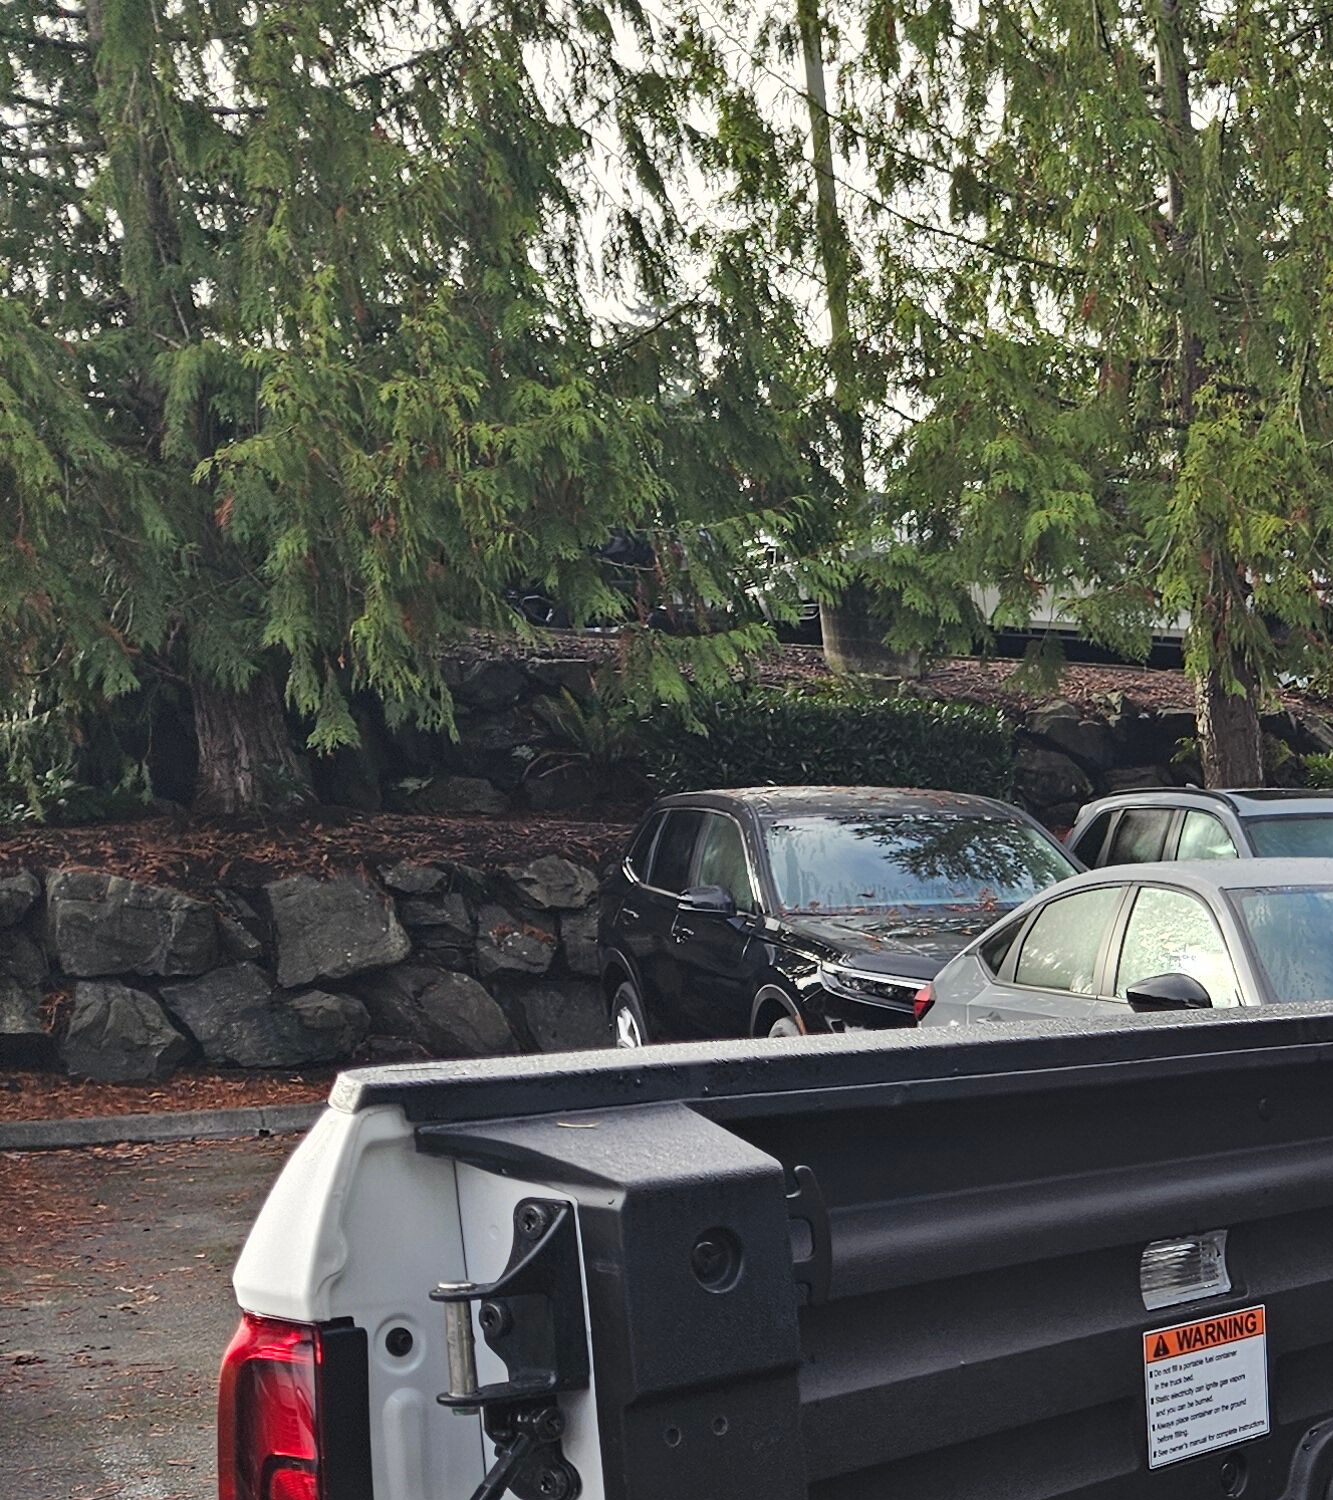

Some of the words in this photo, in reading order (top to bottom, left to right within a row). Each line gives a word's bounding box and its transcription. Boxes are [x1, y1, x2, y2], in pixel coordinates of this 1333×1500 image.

[1176, 1313, 1257, 1351] WARNING
[1154, 1369, 1161, 1377] Do
[1183, 1359, 1204, 1370] portable
[1205, 1355, 1214, 1363] fuel
[1215, 1350, 1237, 1361] container
[1155, 1394, 1170, 1403] Static
[1171, 1388, 1194, 1400] electricity
[1195, 1385, 1204, 1393] can
[1205, 1381, 1218, 1391] ignite
[1160, 1381, 1168, 1389] the
[1169, 1378, 1182, 1386] truck
[1156, 1409, 1165, 1417] and
[1167, 1407, 1176, 1416] you
[1157, 1421, 1174, 1430] Always
[1176, 1416, 1189, 1426] place
[1190, 1409, 1213, 1421] container
[1221, 1404, 1229, 1412] the
[1230, 1398, 1247, 1411] ground
[1157, 1434, 1173, 1443] before
[1158, 1449, 1168, 1457] See
[1189, 1436, 1207, 1447] manual
[1216, 1427, 1238, 1440] complete
